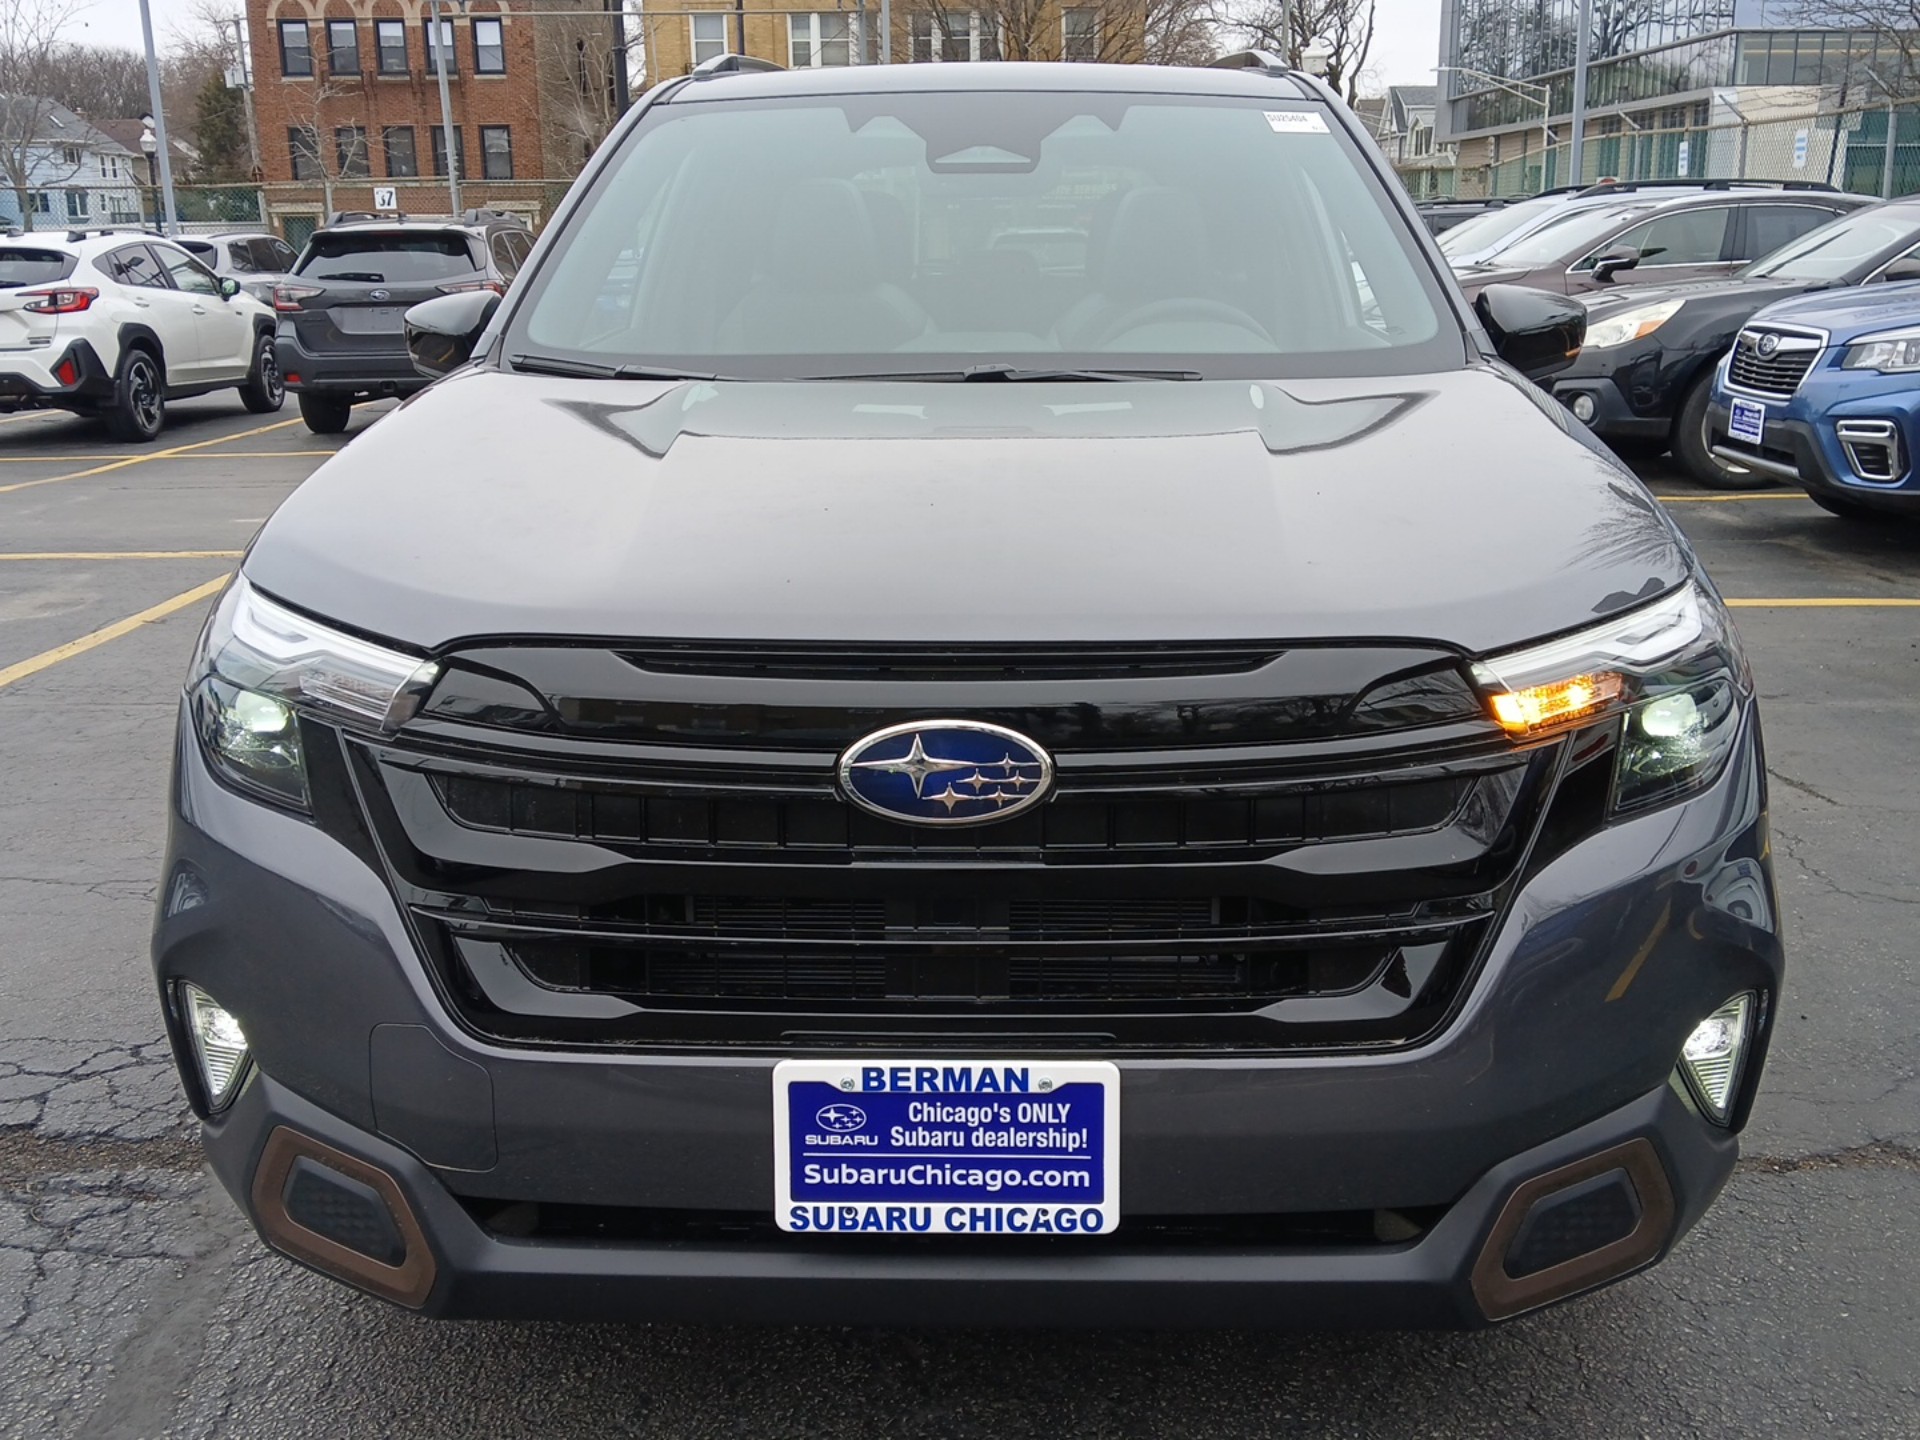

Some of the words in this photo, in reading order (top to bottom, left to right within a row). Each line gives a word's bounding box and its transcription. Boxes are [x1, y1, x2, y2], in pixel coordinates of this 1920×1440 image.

[861, 1067, 1030, 1093] BERMAN
[908, 1102, 1011, 1126] Chicago's
[1017, 1103, 1071, 1124] ONLY
[805, 1134, 878, 1146] SUBARU
[890, 1126, 965, 1147] Subaru
[971, 1127, 1088, 1152] dealership!
[803, 1163, 1090, 1192] SubaruChicago.com
[789, 1206, 932, 1232] SUBARU
[944, 1207, 1104, 1233] CHICAGO
